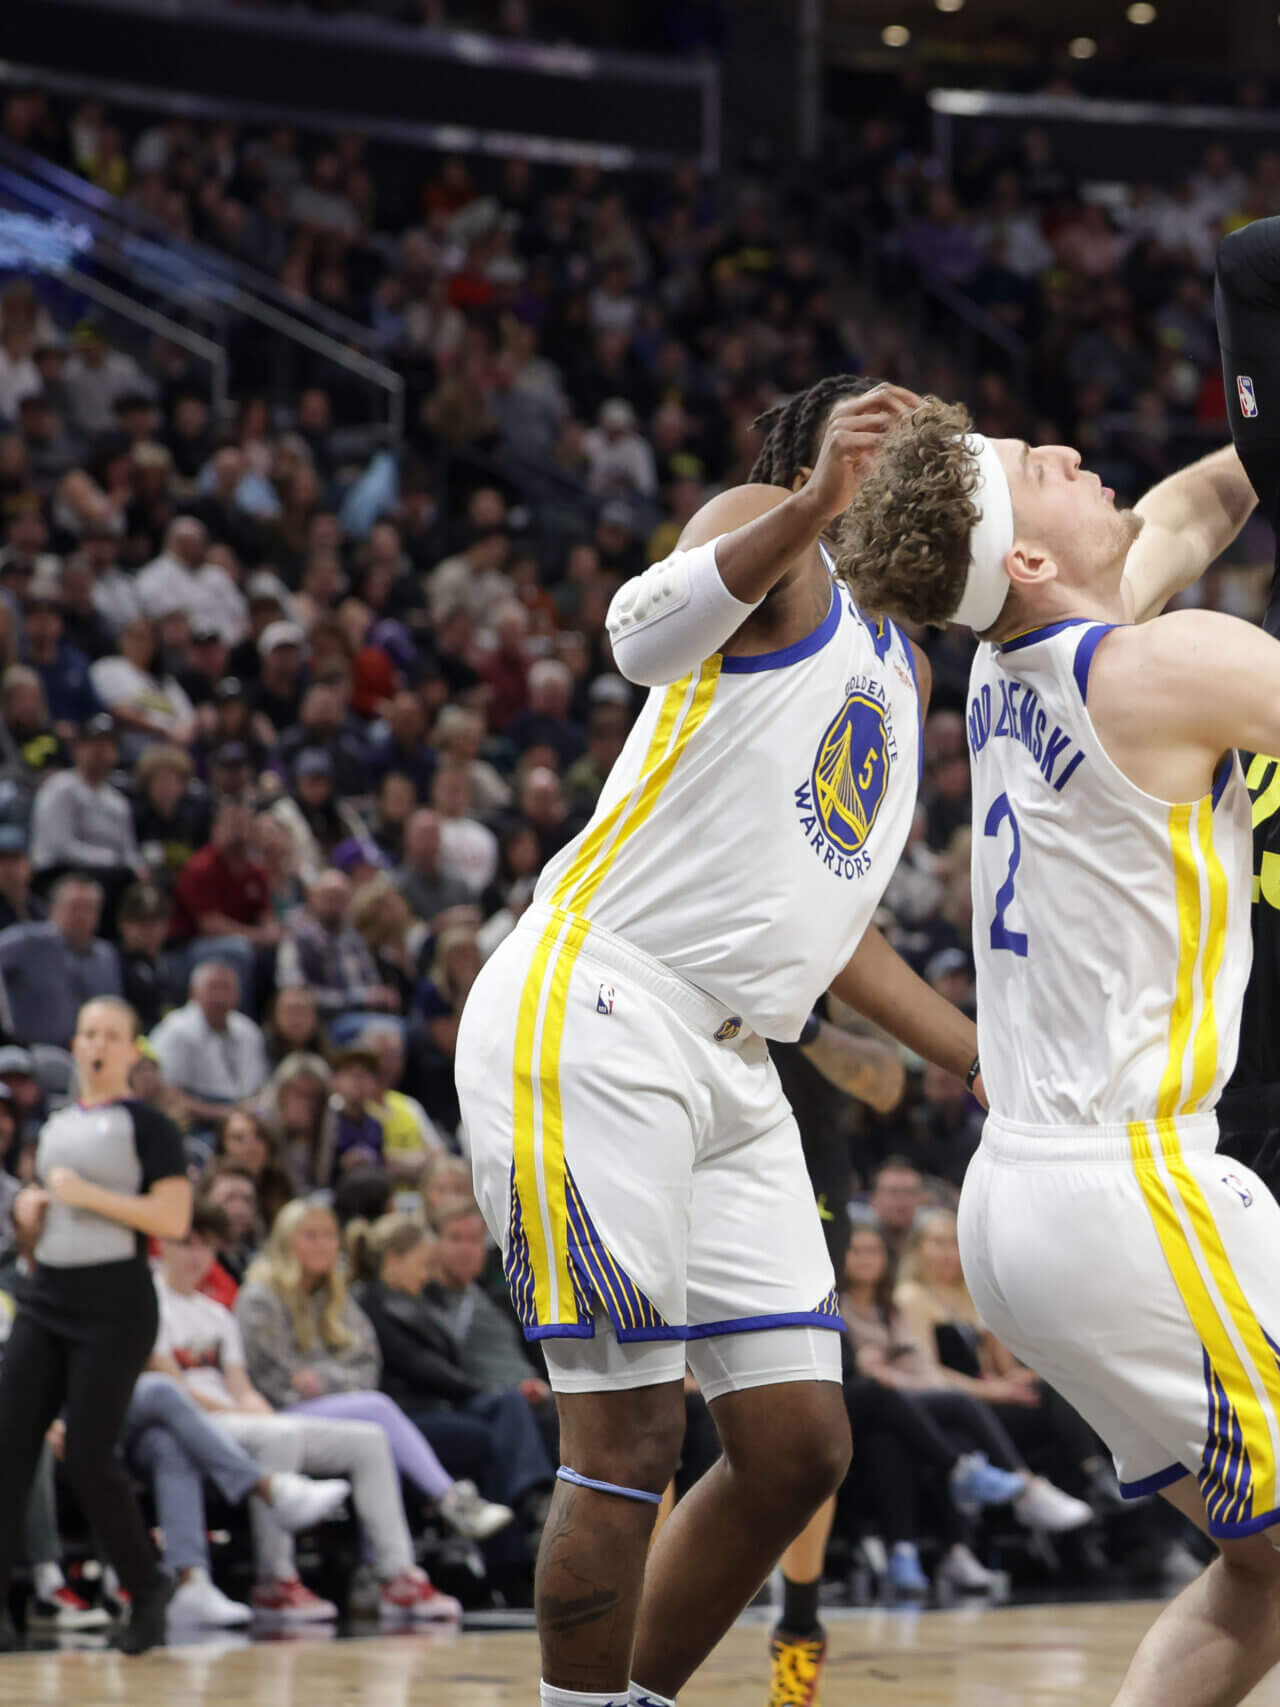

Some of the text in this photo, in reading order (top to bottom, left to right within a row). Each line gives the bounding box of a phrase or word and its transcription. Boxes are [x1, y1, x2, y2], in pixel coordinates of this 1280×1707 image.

[845, 674, 886, 702] GOLDEN
[858, 746, 879, 791] 5
[794, 778, 872, 880] WARRIORS
[983, 791, 1029, 958] 2
